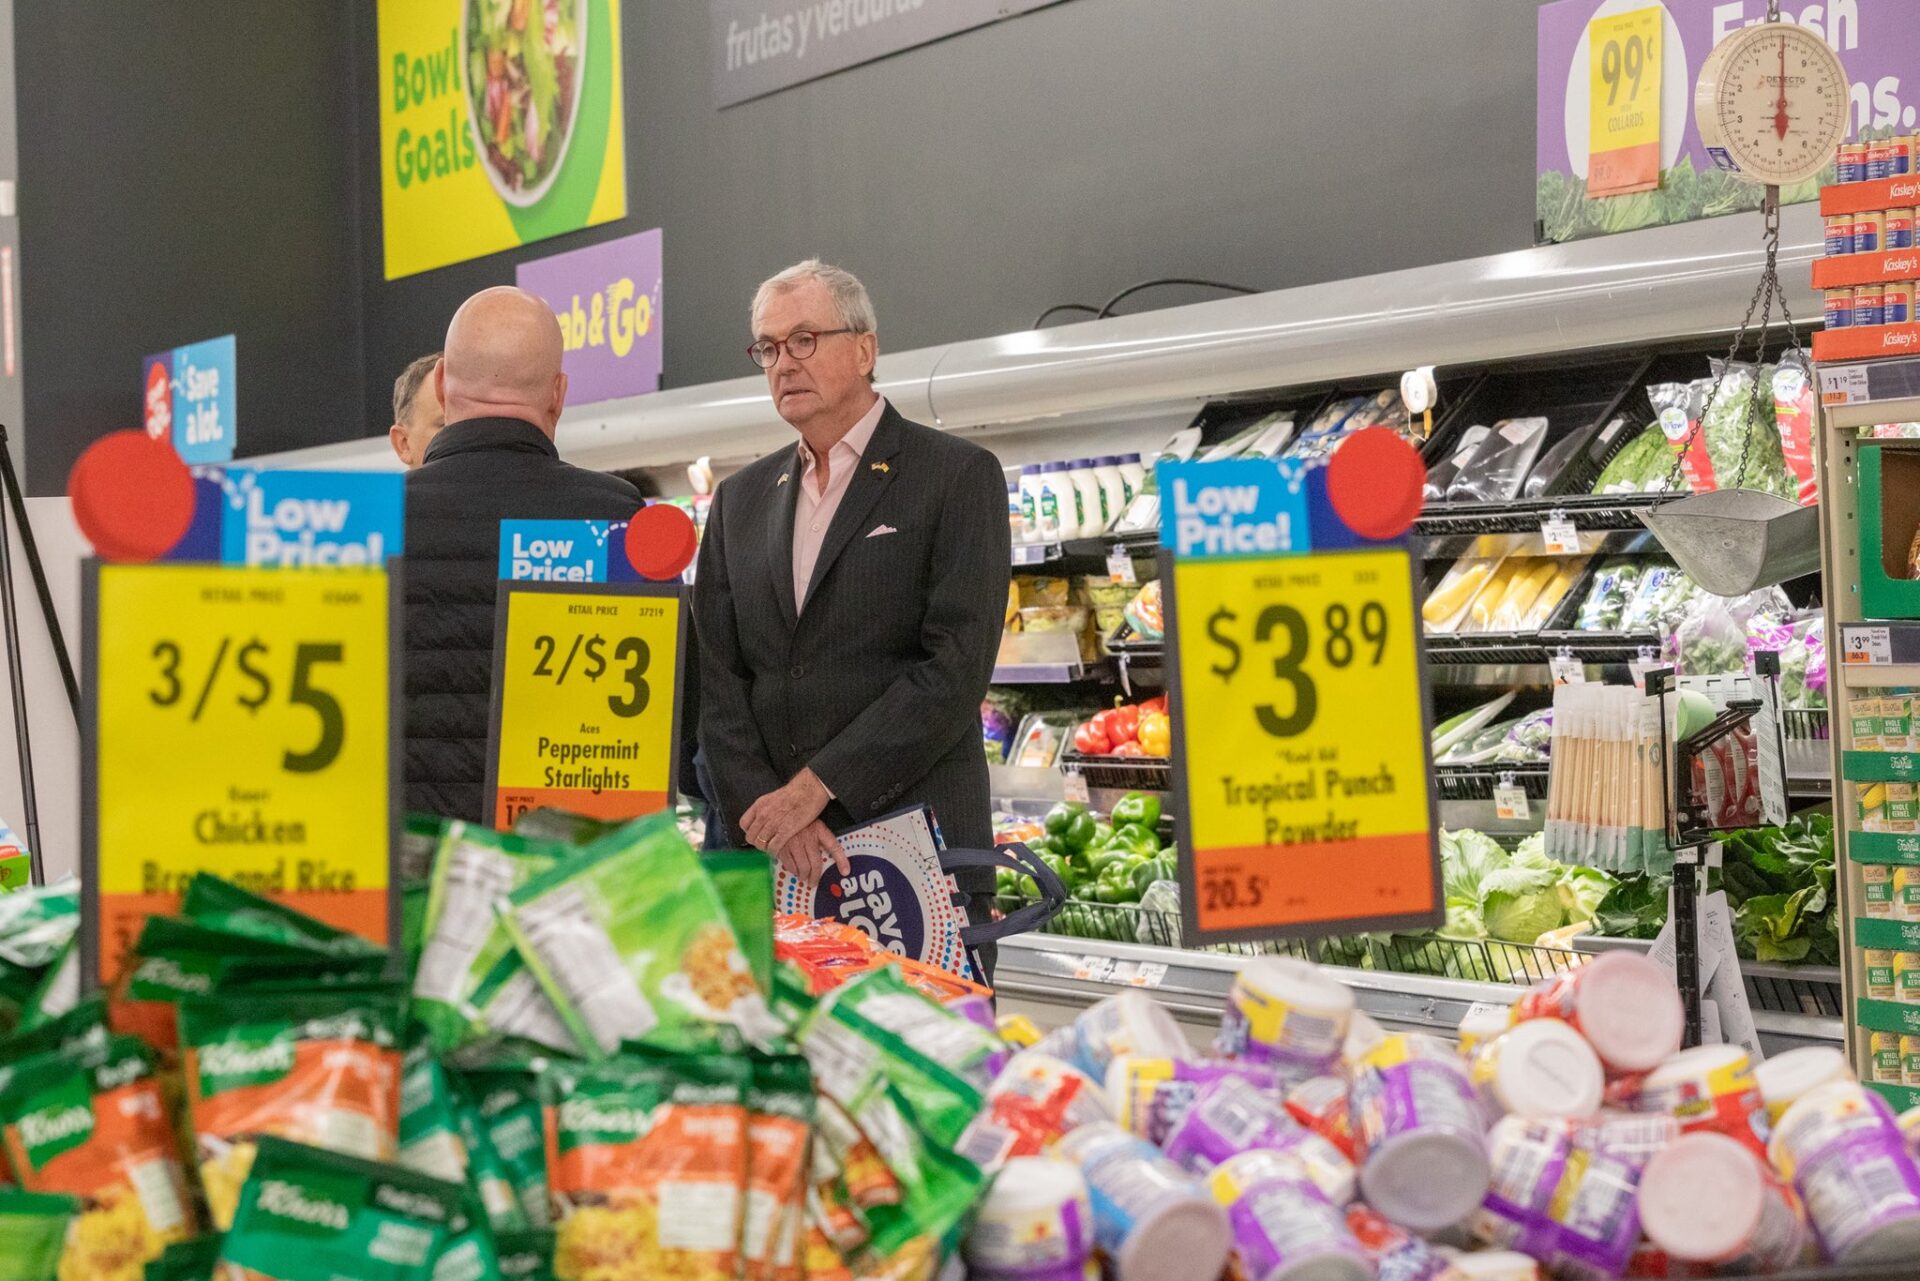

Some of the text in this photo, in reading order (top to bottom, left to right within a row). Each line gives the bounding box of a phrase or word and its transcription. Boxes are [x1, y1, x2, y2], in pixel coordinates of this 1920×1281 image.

[392, 26, 461, 114] Bowl
[1608, 111, 1644, 133] COLLARDS
[395, 114, 476, 191] Goals
[1882, 256, 1918, 274] Kaskey's
[1882, 330, 1918, 348] Kaskey's
[246, 486, 350, 532] Low
[1173, 477, 1259, 516] Low
[512, 532, 574, 559] Low
[1176, 511, 1292, 556] Price!
[511, 559, 594, 582] Price!
[568, 604, 593, 615] RETAIL
[595, 605, 619, 616] PRICE
[579, 722, 600, 735] Aces
[537, 736, 640, 764] Peppermint
[544, 765, 630, 795] Starlights
[1221, 763, 1397, 813] Tropical Punch
[194, 809, 308, 846] Chicken
[1264, 810, 1359, 848] Powder
[297, 859, 357, 896] Rice
[1872, 976, 1891, 984] KERNEL
